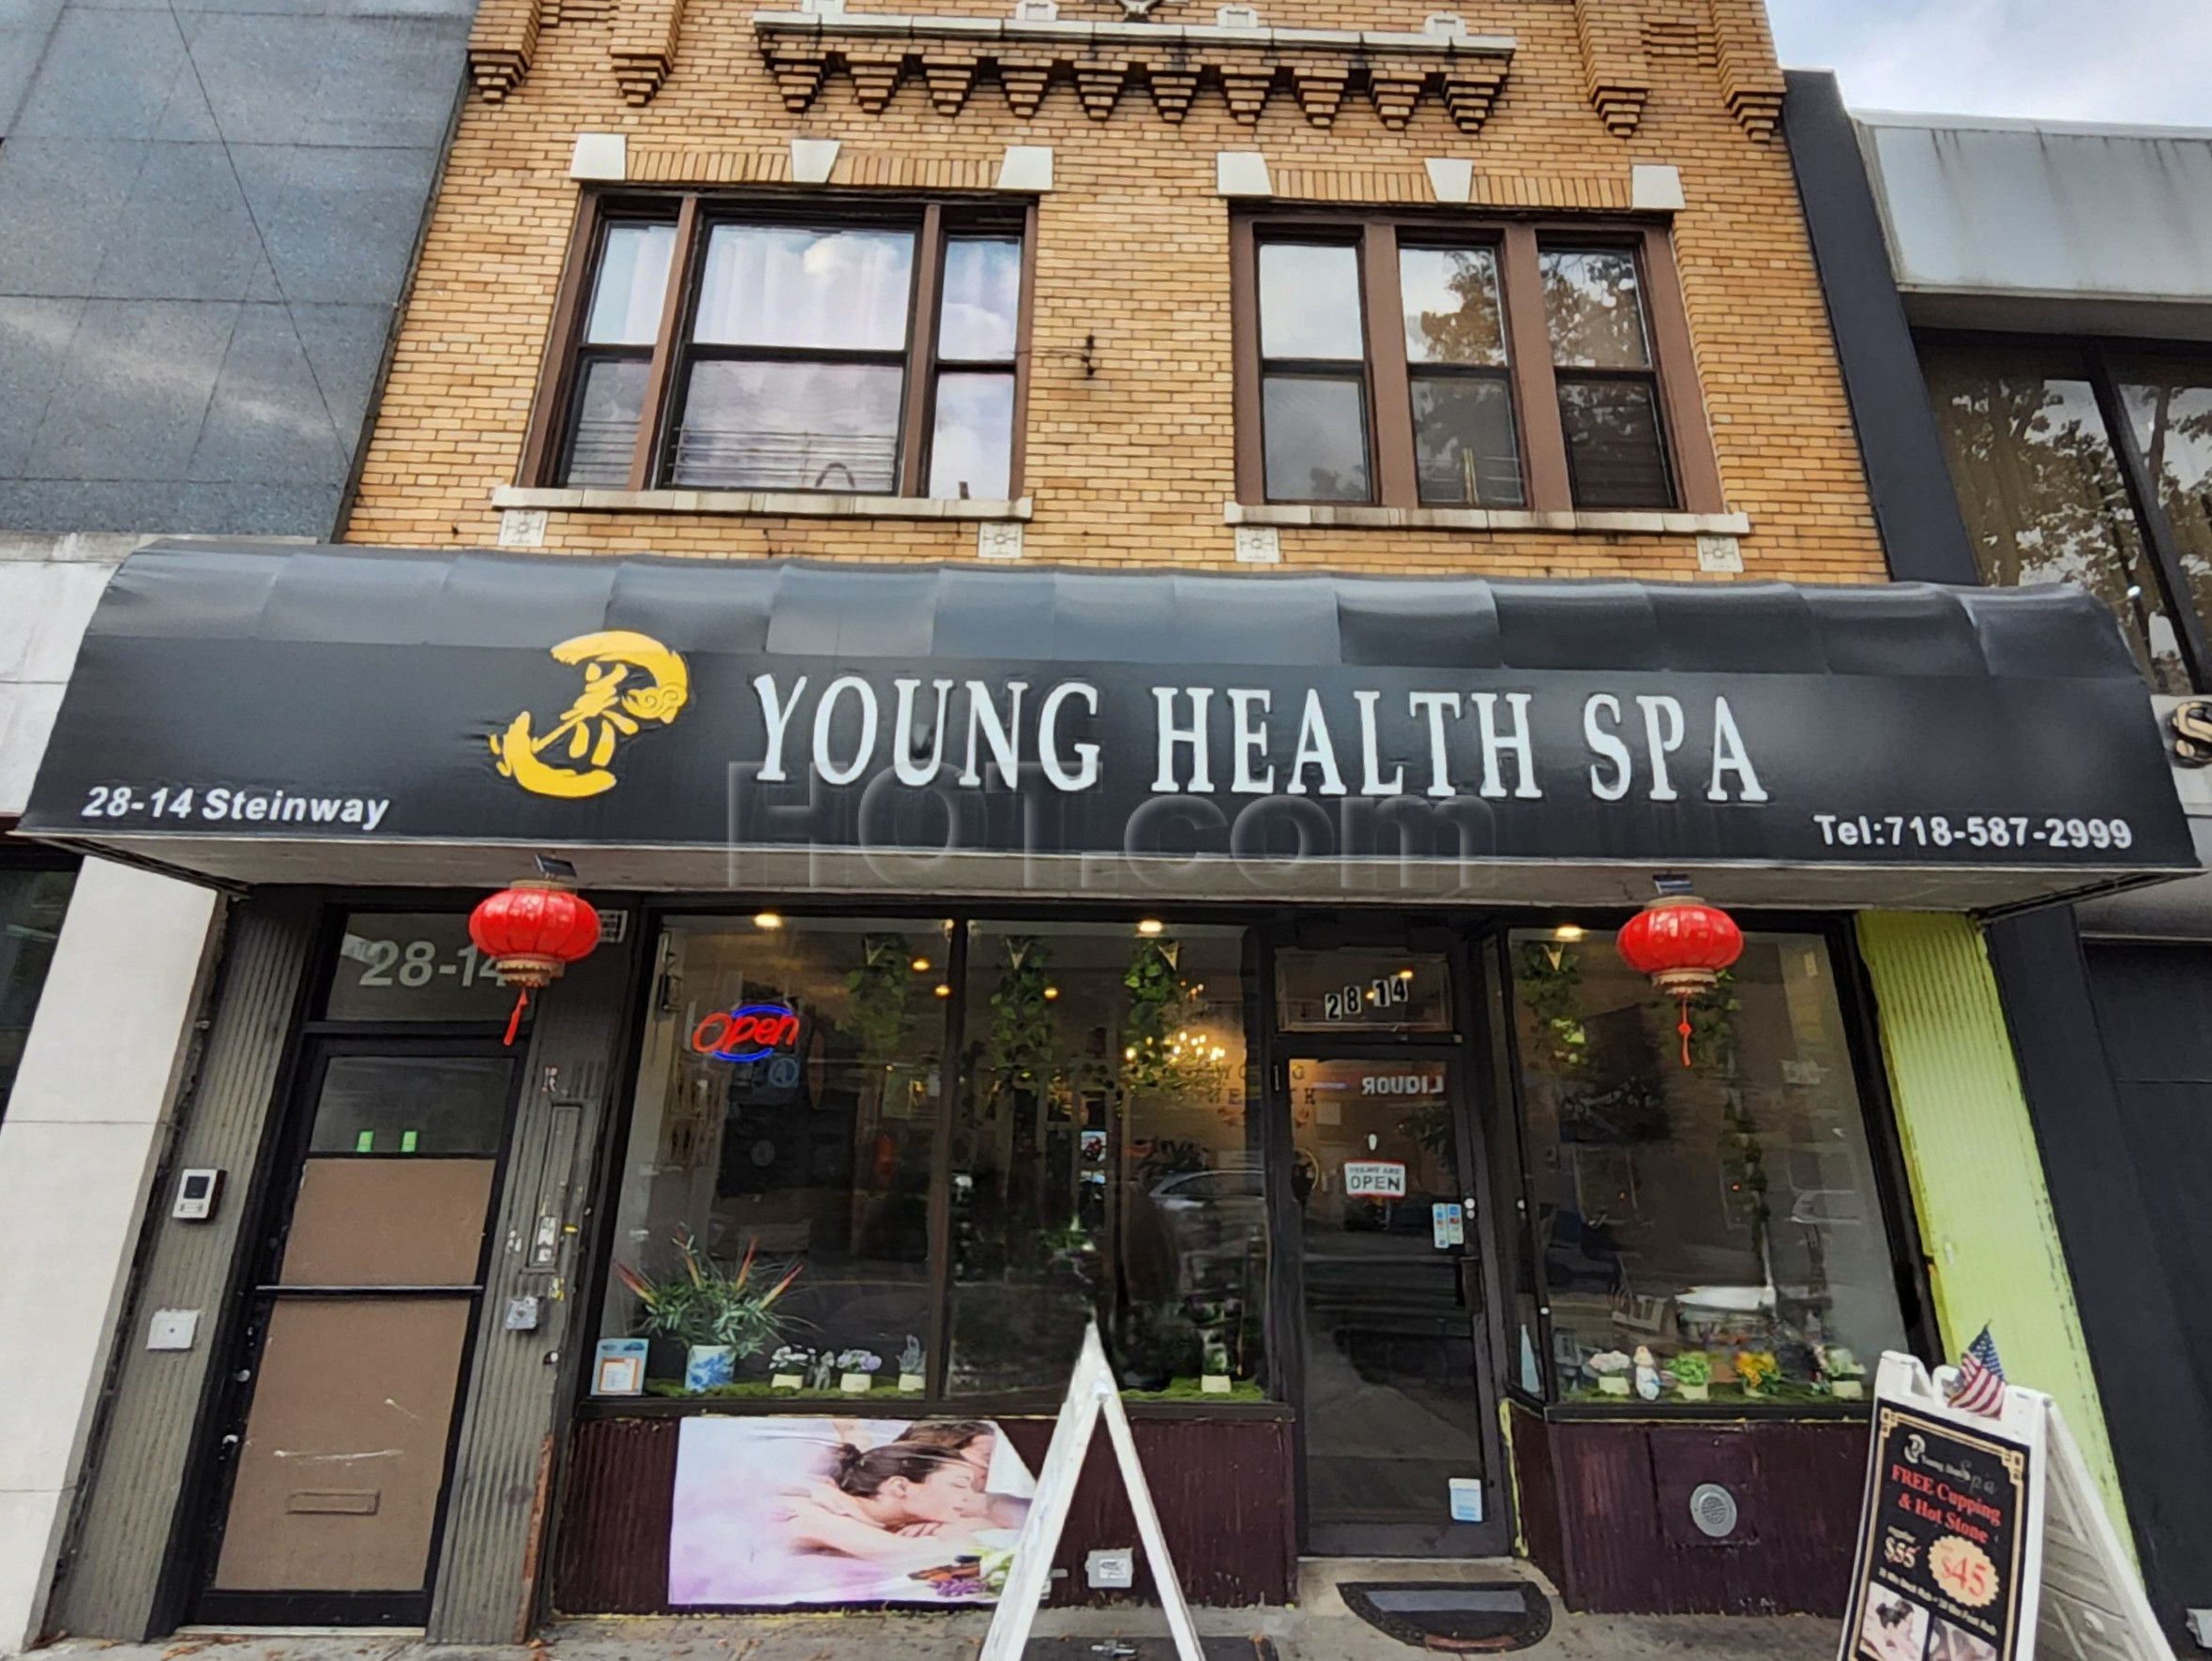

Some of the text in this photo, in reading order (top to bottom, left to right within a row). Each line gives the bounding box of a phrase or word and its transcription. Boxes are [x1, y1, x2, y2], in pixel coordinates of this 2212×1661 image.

[752, 673, 1769, 803] YOUNG HEALTH SPA
[82, 786, 389, 831] 28-14 Steinway
[1812, 814, 2133, 850] Tel:718-587-2999
[692, 1012, 799, 1053] Open
[1351, 1175, 1400, 1190] OPEN
[1891, 1463, 1935, 1495] FREE
[1936, 1482, 2002, 1528] Cupping
[1898, 1492, 1912, 1511] &
[1916, 1498, 1943, 1525] Hot
[1945, 1512, 1989, 1545] Stone
